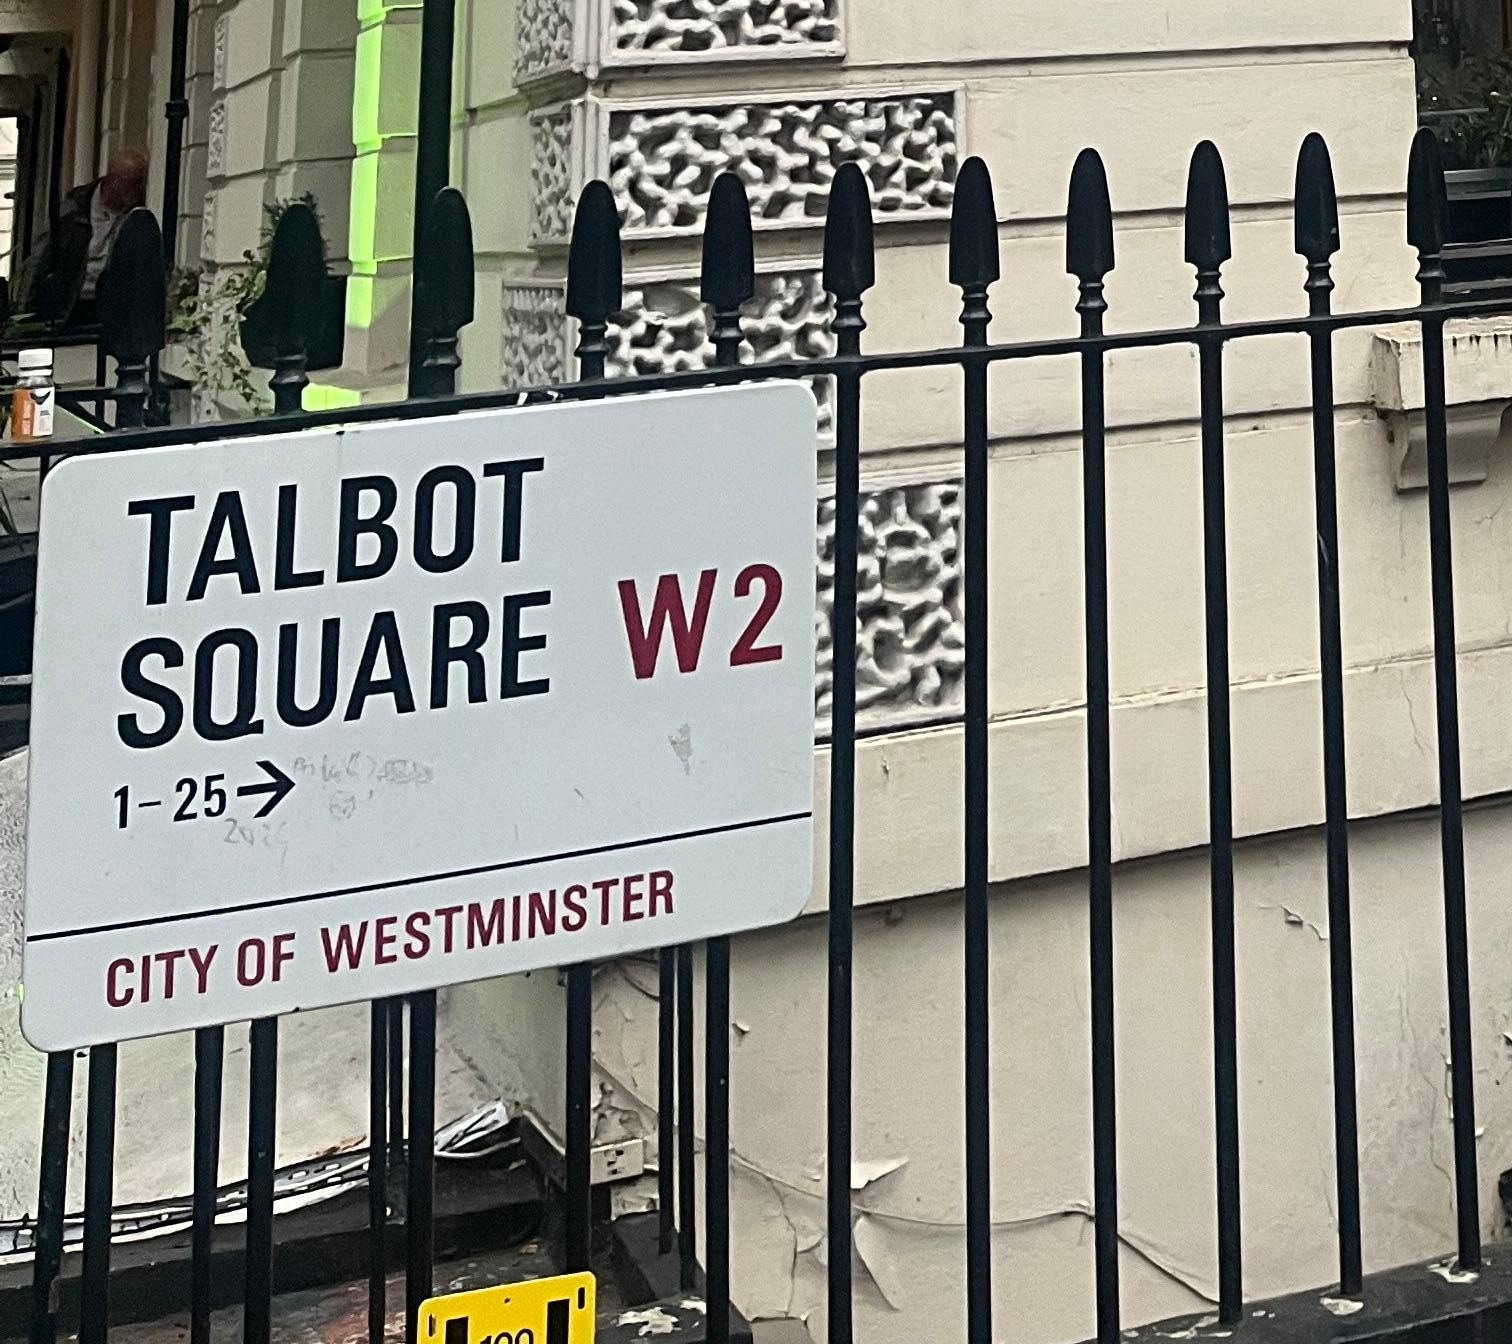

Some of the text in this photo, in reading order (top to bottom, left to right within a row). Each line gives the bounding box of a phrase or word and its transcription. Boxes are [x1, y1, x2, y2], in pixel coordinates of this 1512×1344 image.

[127, 457, 545, 605] TALBOT
[117, 564, 784, 749] SQUARE W2
[107, 870, 675, 1007] CITY OF WESTMINSTER
